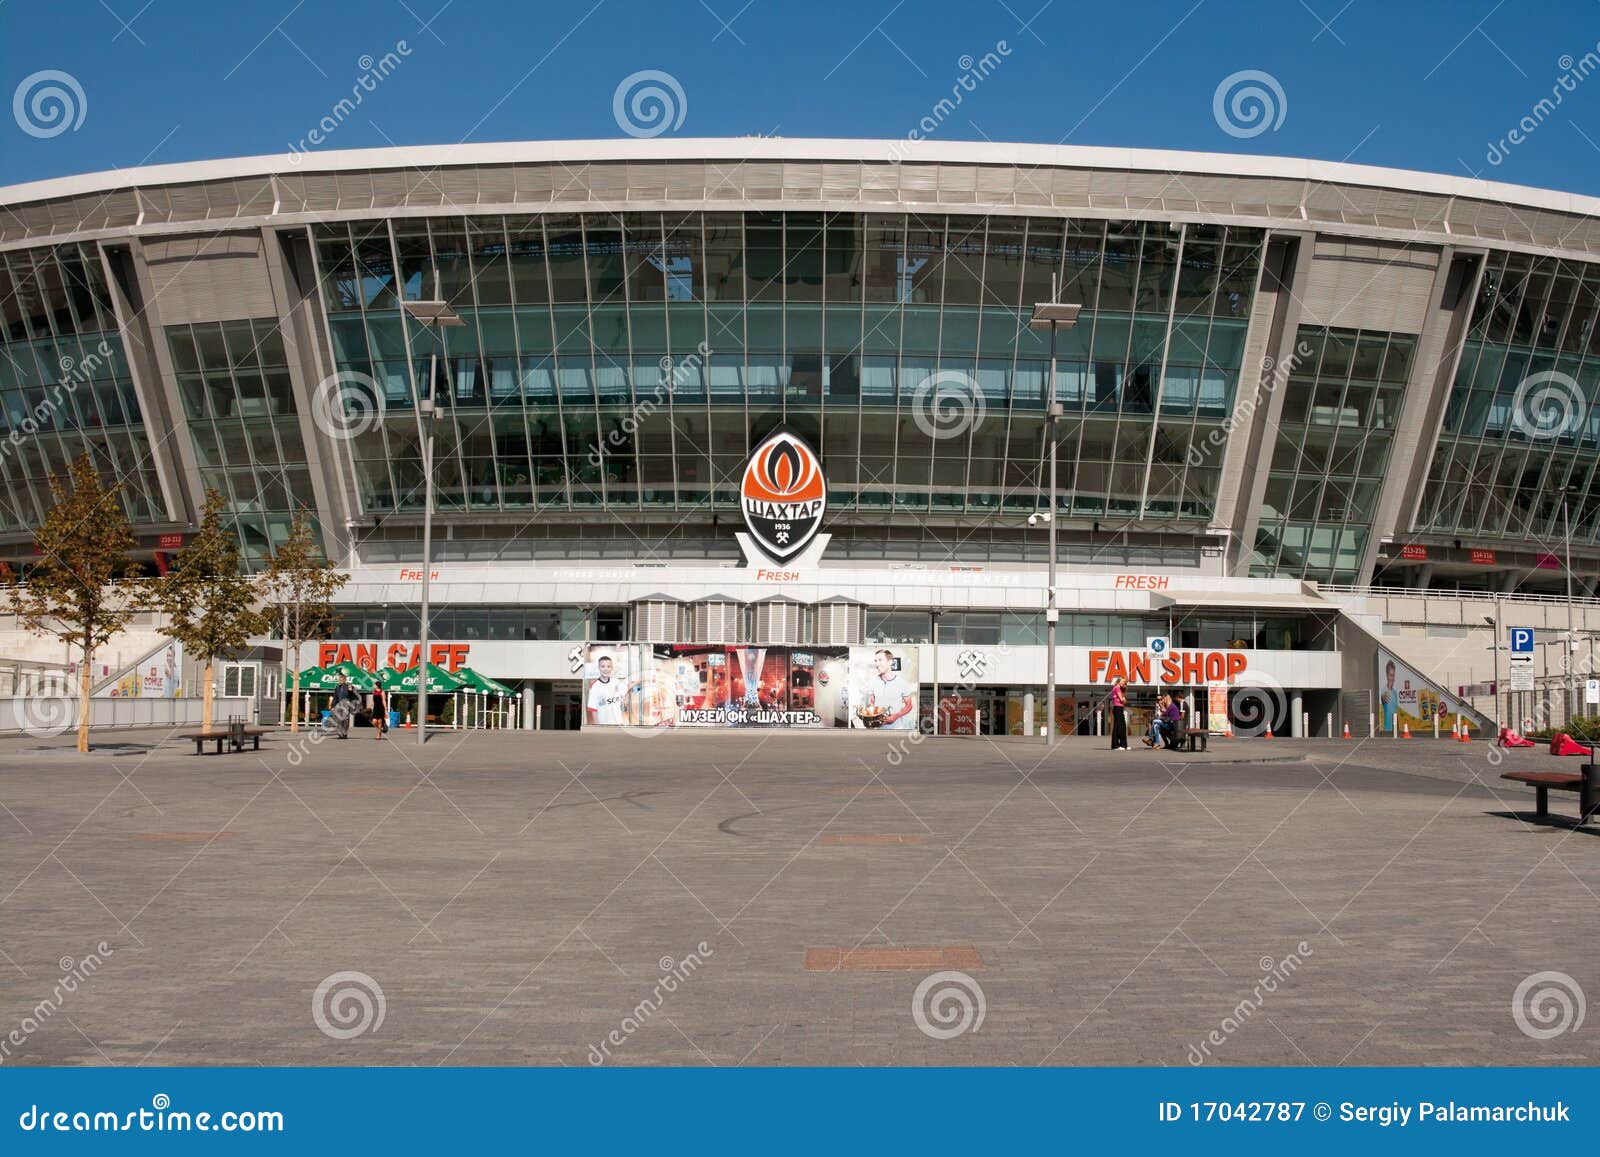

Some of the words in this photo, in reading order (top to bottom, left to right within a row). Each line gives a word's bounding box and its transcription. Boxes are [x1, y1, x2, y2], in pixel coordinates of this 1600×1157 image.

[746, 498, 822, 519] ШАХТАР
[774, 523, 791, 531] 1936
[400, 568, 439, 580] FREH
[757, 569, 799, 581] FRESH
[1115, 575, 1169, 589] FRESH
[1515, 631, 1529, 650] P
[319, 643, 377, 674] FAN
[1089, 651, 1150, 683] FAN
[1161, 651, 1247, 684] SHOP
[680, 708, 725, 723] МУЗЕЙ
[727, 709, 748, 723] ФК
[750, 710, 821, 724] «ШАХТЕР»
